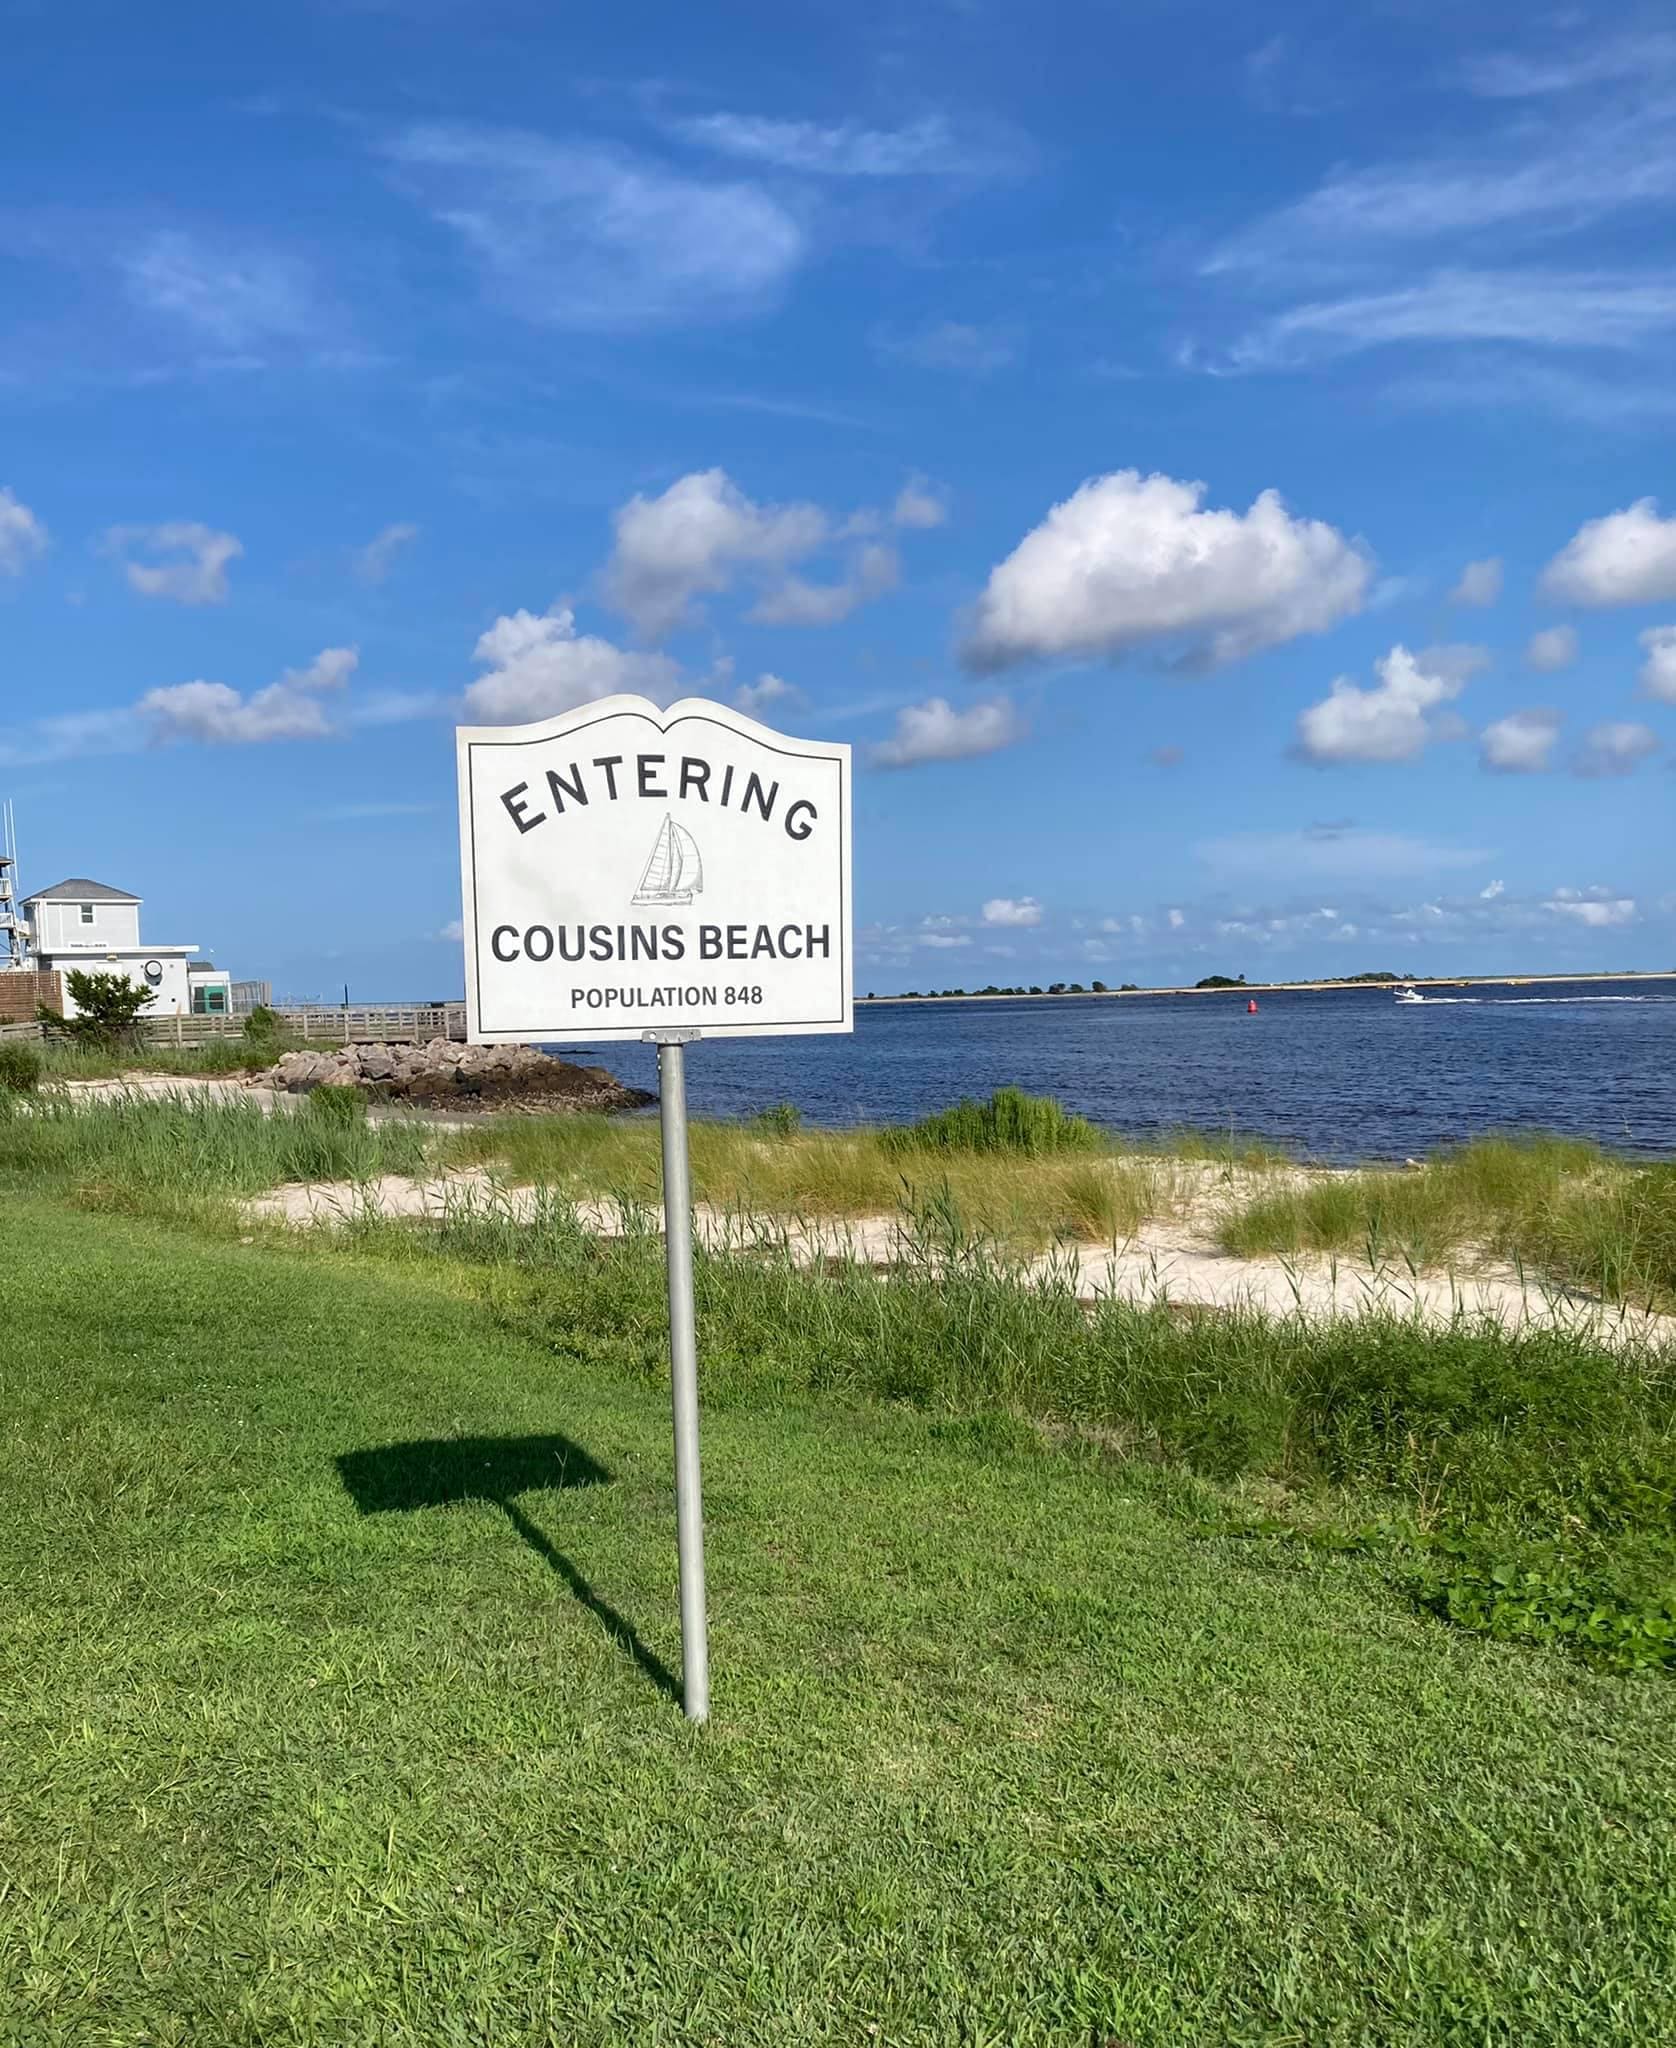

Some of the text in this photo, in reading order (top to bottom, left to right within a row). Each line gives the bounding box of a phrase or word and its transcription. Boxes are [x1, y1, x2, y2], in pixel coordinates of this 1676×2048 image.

[500, 754, 818, 841] ENTERING
[491, 924, 830, 962] COUSINS BEACH
[571, 985, 763, 1009] POPULATION 848
